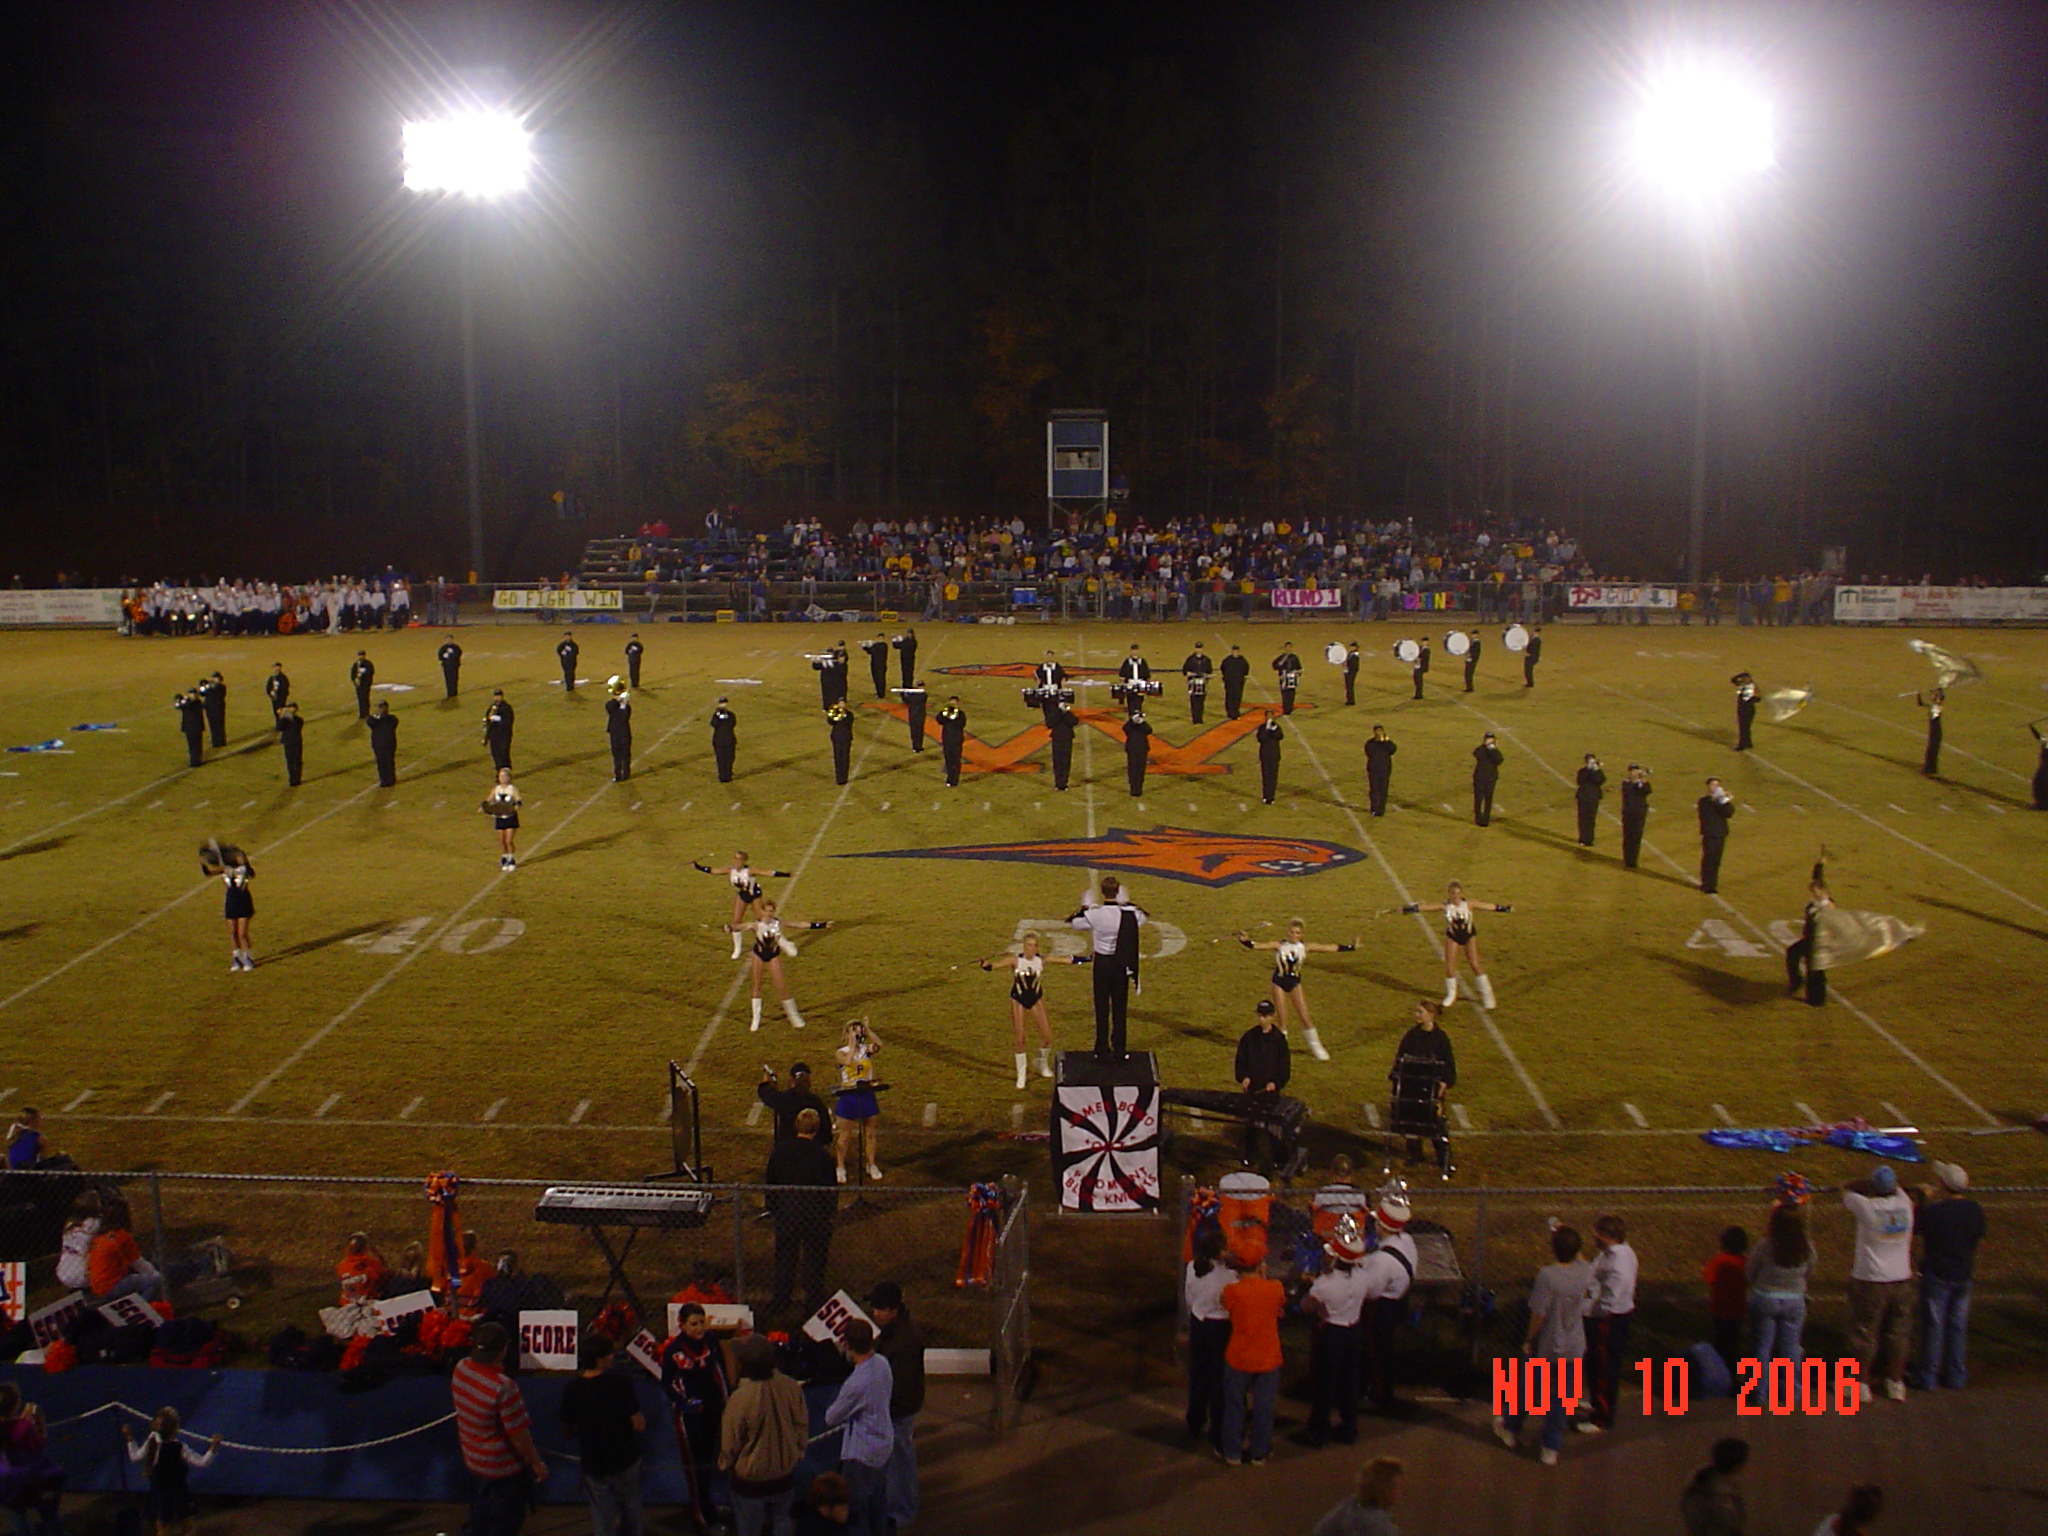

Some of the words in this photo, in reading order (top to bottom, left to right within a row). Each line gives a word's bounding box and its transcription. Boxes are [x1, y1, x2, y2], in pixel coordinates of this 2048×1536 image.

[499, 591, 518, 606] GO
[526, 591, 575, 606] FIGHT
[583, 590, 619, 606] WIN
[1274, 588, 1323, 606] ROUND
[1327, 589, 1338, 605] 1
[1118, 1101, 1155, 1126] BOD
[1105, 1173, 1158, 1204] KNITS
[520, 1325, 576, 1355] SCORE
